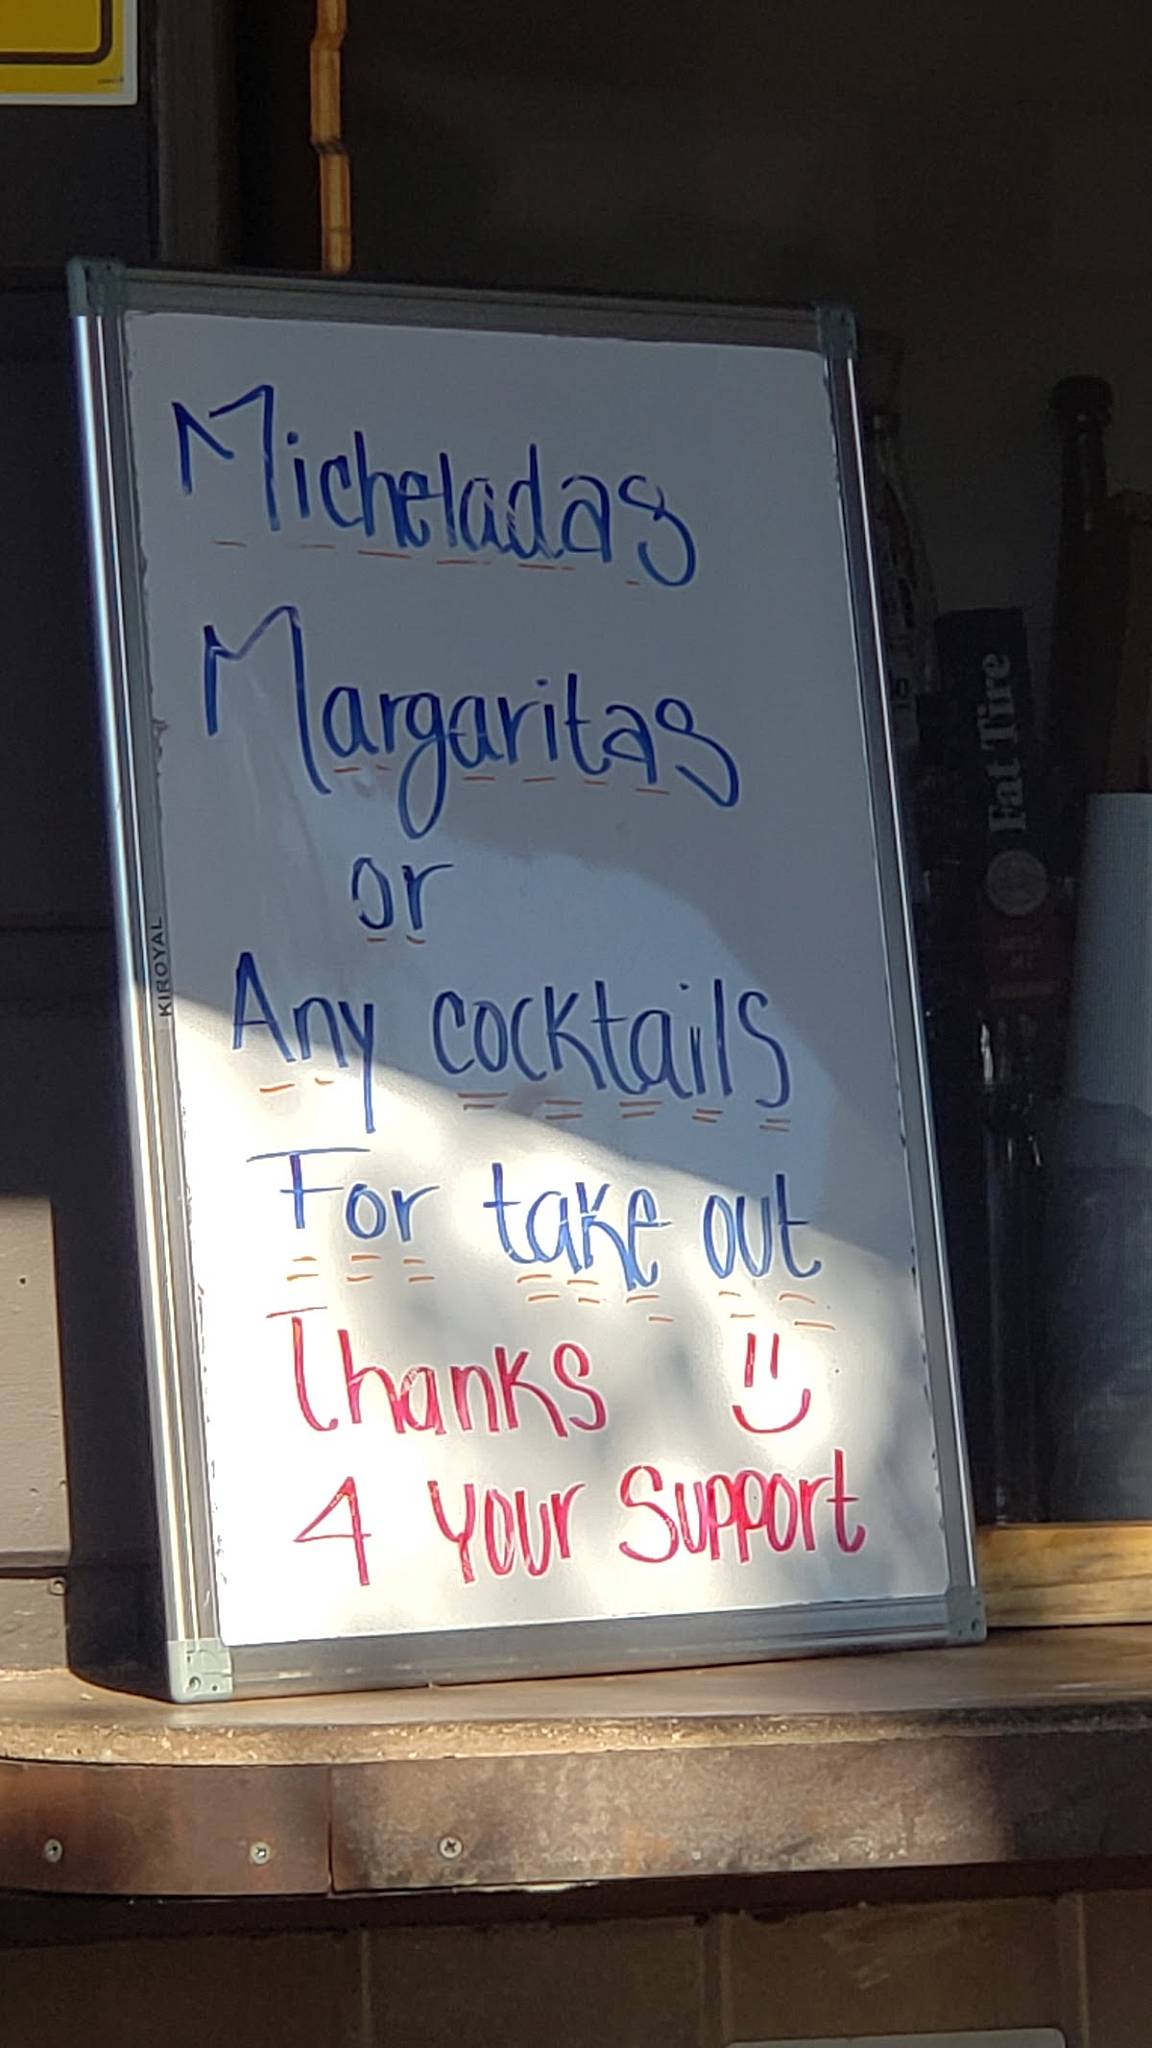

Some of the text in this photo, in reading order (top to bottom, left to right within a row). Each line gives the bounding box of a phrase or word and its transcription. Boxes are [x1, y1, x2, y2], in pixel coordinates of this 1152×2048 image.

[171, 384, 697, 587] Micheladas
[203, 606, 740, 841] Margaritas
[977, 652, 1027, 832] Fat Tire
[351, 856, 454, 931] or
[151, 916, 173, 1017] KIROYAL
[232, 951, 791, 1134] Any cocktails
[246, 1147, 822, 1292] For take out
[266, 1306, 608, 1438] Thanks
[293, 1475, 372, 1586] 4
